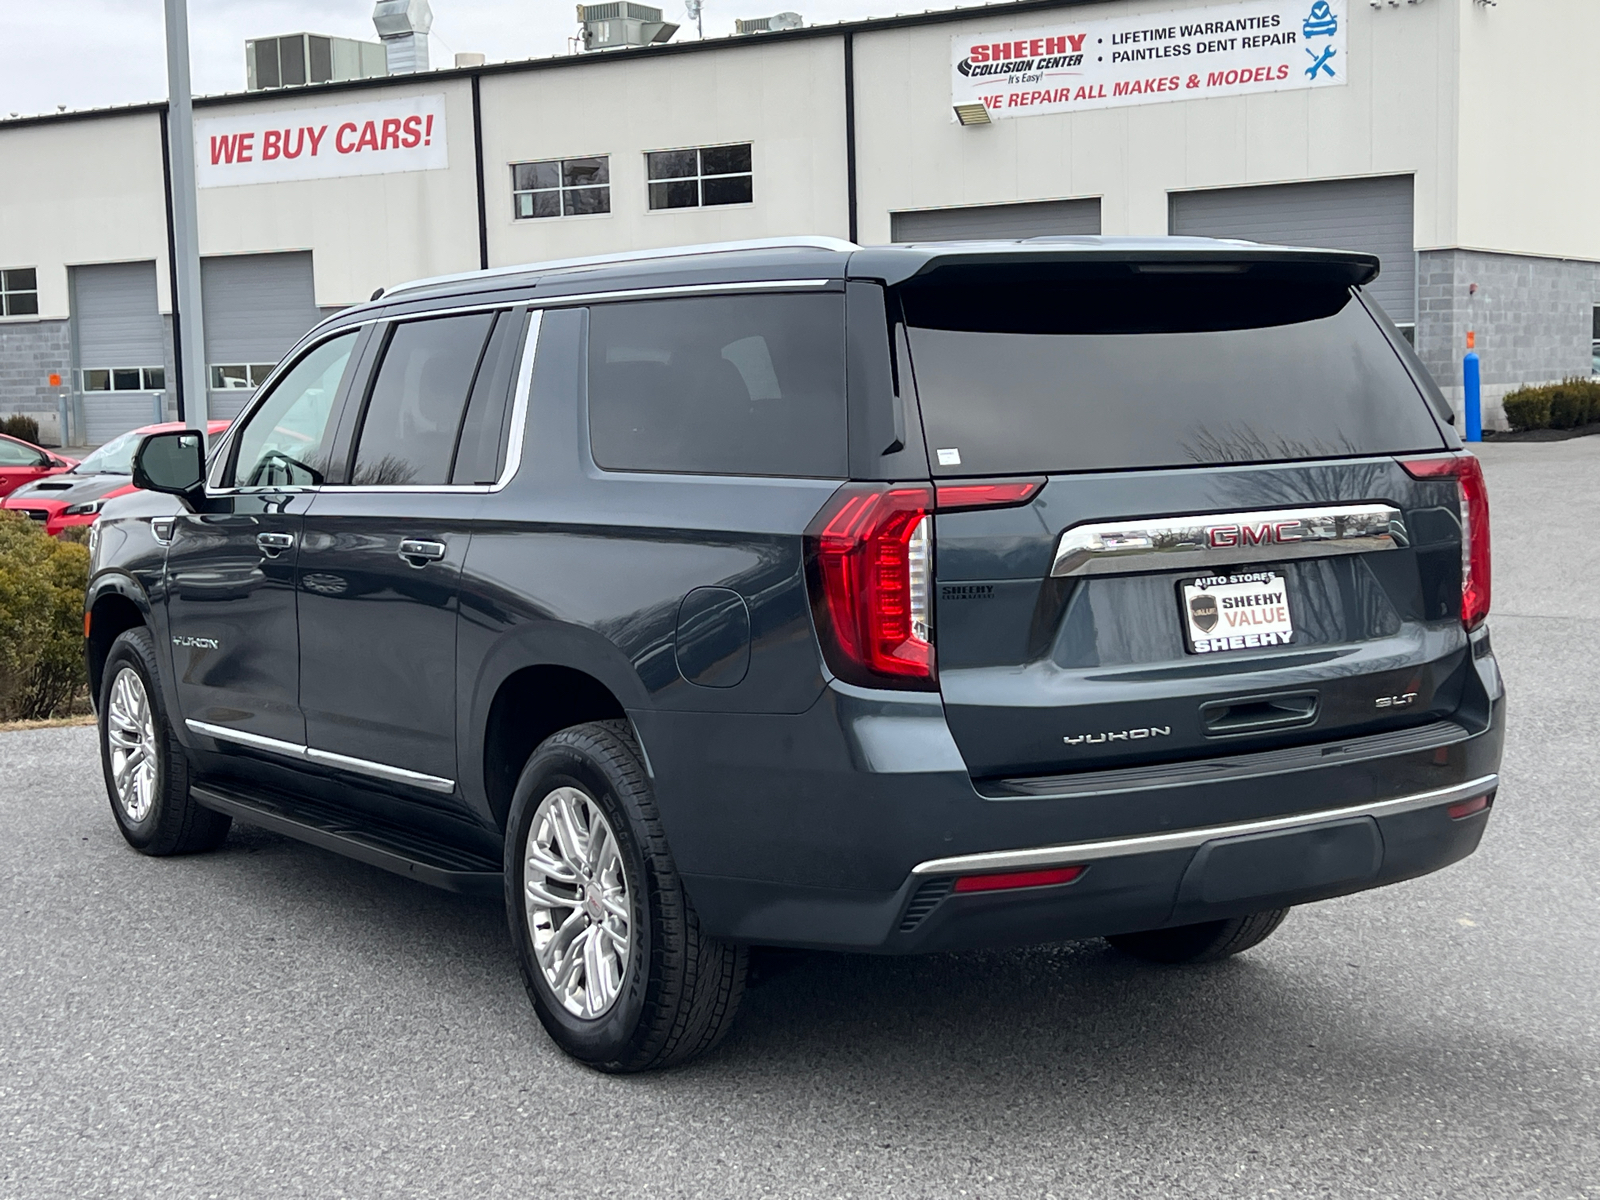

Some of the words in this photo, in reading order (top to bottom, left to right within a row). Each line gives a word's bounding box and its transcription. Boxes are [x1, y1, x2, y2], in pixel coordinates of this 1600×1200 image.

[1112, 27, 1176, 45] LIFETIME
[1179, 14, 1281, 38] WARRANTIES
[970, 33, 1087, 63] SHEEHY
[1112, 43, 1191, 63] PAINTLESS
[1196, 38, 1238, 54] DENT
[1241, 31, 1297, 49] REPAIR
[971, 59, 1035, 77] COLLISION
[1036, 54, 1084, 70] CENTER
[1007, 73, 1020, 84] It's
[1021, 71, 1044, 84] Easy!
[1008, 87, 1070, 107] REPAIR
[1074, 84, 1108, 100] ALL
[1112, 75, 1180, 97] MAKES
[1185, 73, 1200, 90] &
[1206, 64, 1290, 87] MODELS
[210, 132, 255, 165] WE
[262, 124, 328, 161] BUY
[335, 114, 434, 154] CARS!
[1207, 520, 1302, 549] GMC
[942, 585, 994, 595] SHEEHY
[1194, 576, 1227, 587] AUTO
[1230, 571, 1276, 584] STORES
[1221, 591, 1283, 609] SHEEHY
[1224, 606, 1287, 628] VALUE
[172, 635, 219, 650] YUKON
[1194, 630, 1293, 653] SHEEHY
[1375, 692, 1418, 708] SLT
[1063, 725, 1171, 746] YUKON
